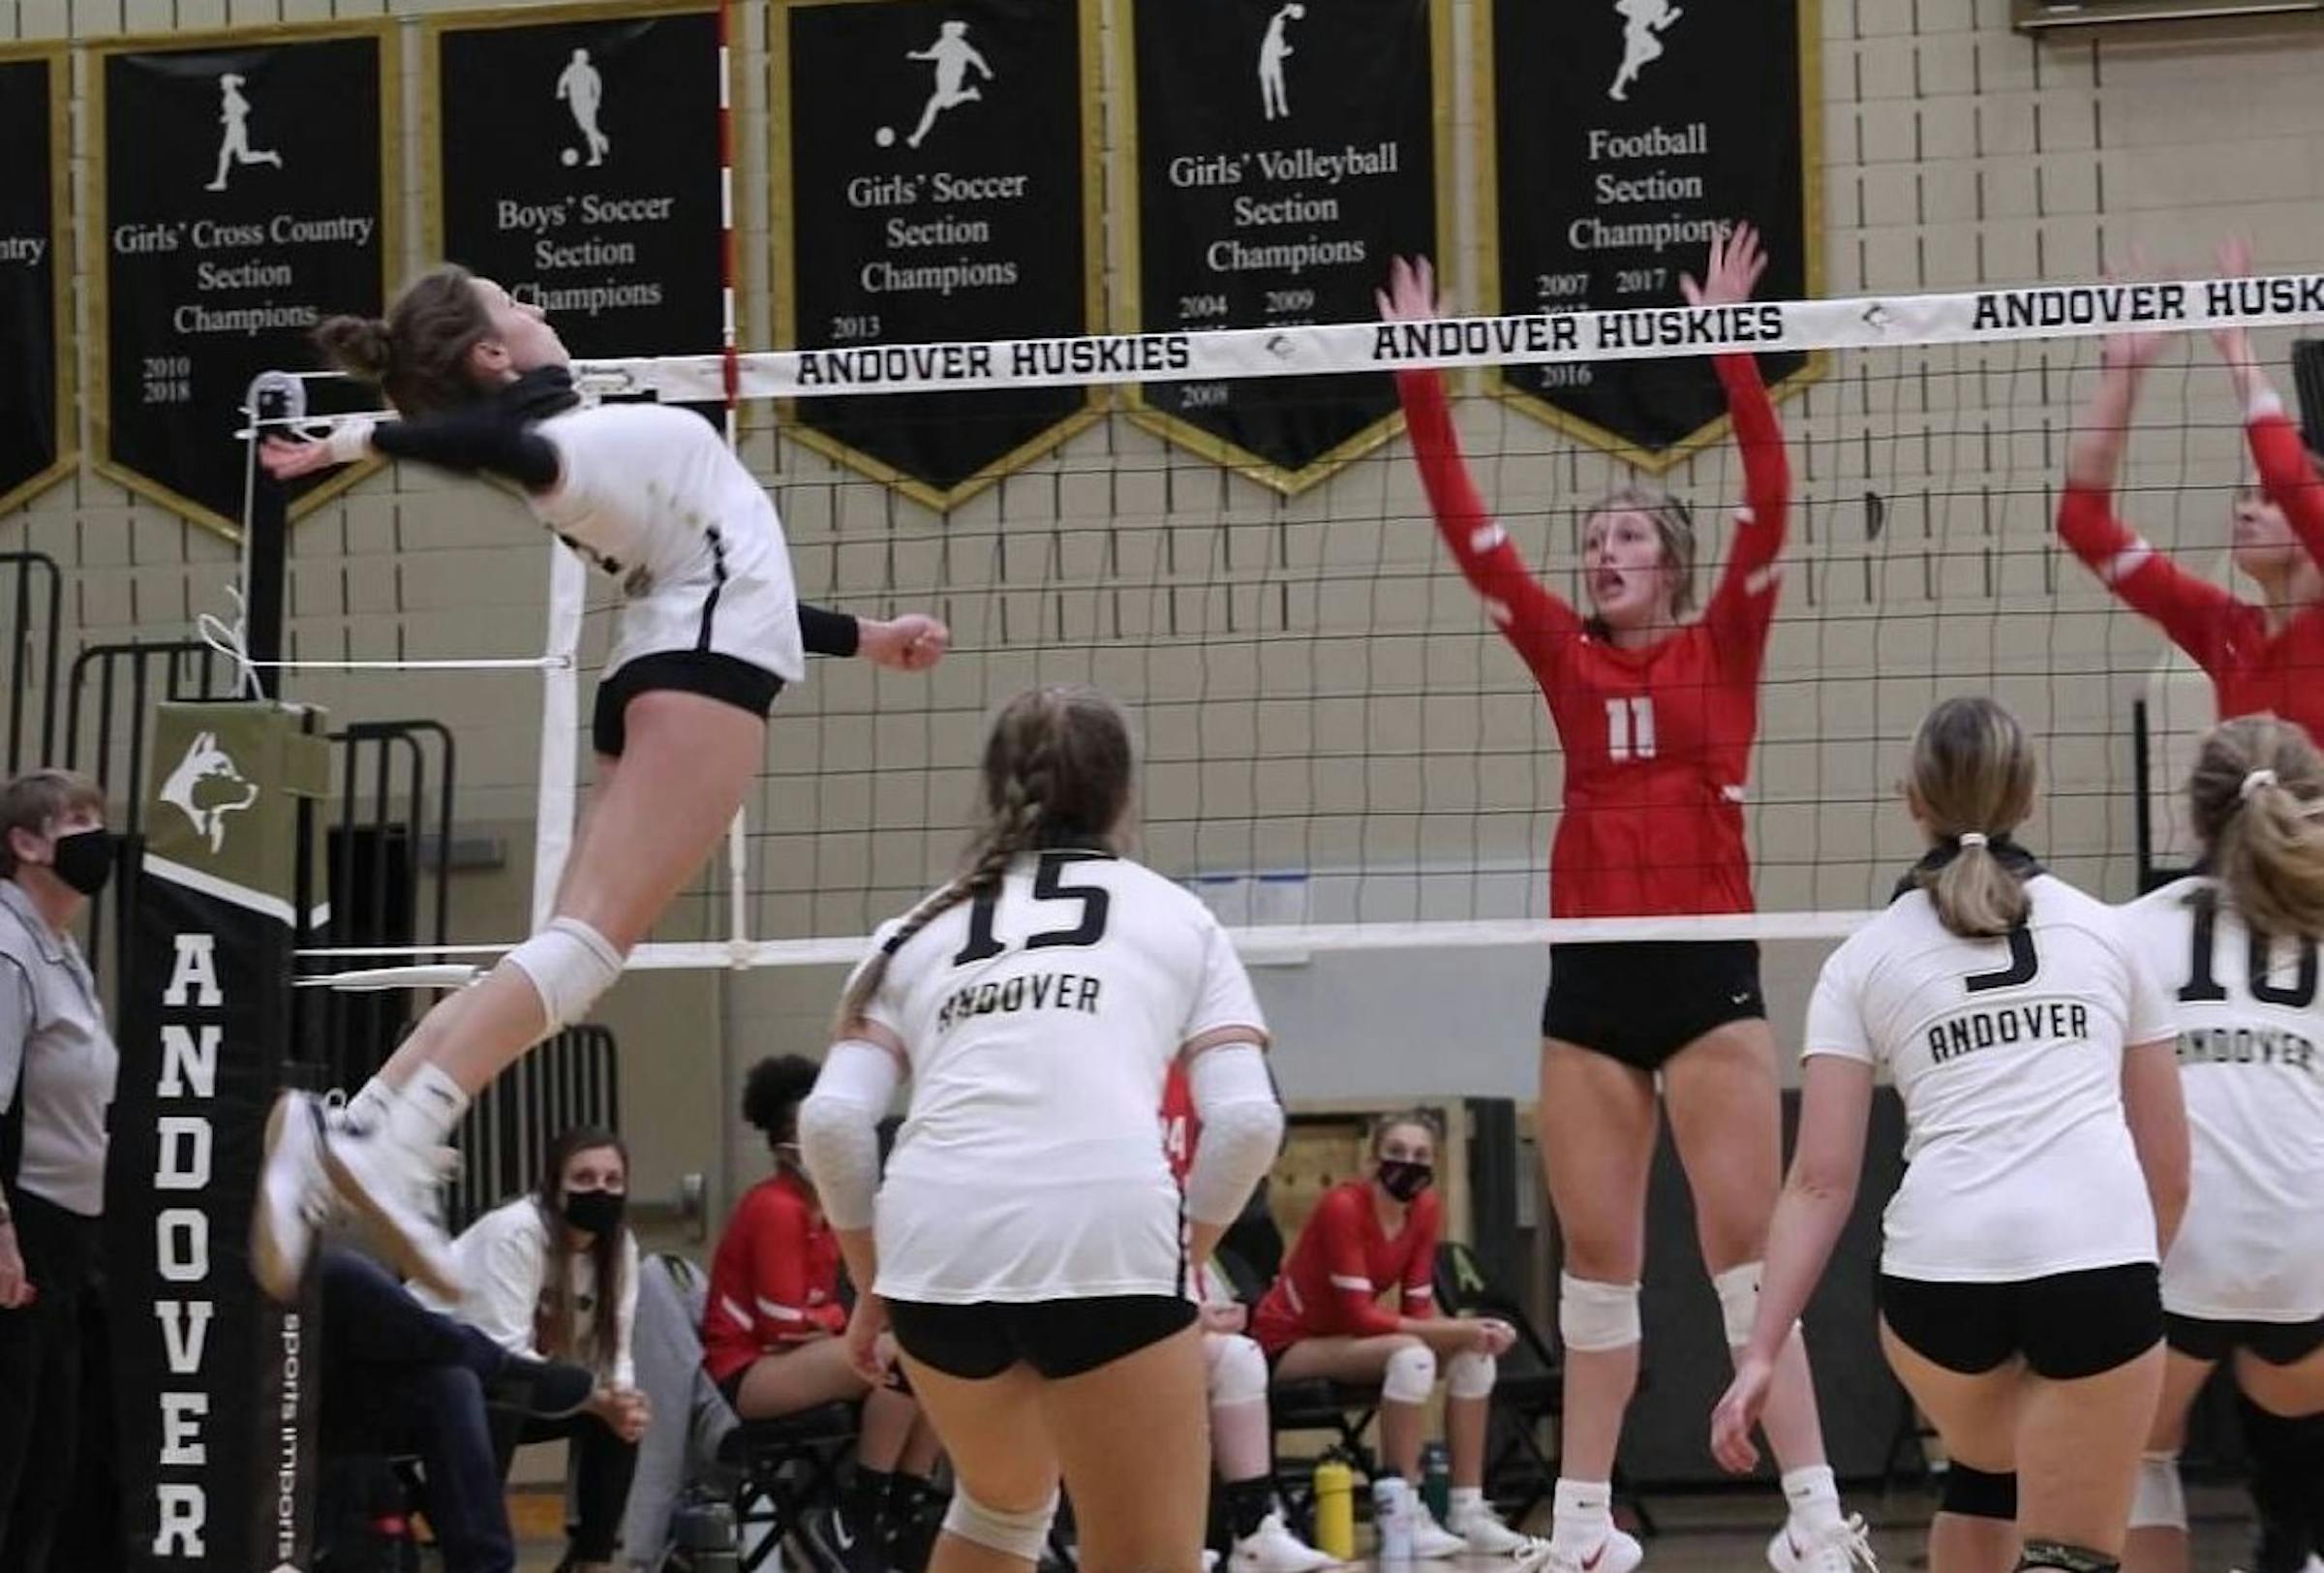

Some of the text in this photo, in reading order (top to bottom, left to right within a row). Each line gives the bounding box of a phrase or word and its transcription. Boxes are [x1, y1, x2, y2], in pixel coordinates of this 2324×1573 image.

[1588, 123, 1708, 160] Football
[1169, 142, 1398, 187] Girls' Volleyball
[847, 172, 1028, 207] Girls' Soccer
[1595, 170, 1703, 204] Section
[498, 194, 675, 233] Boys' Soccer
[1234, 193, 1339, 226] Section
[114, 215, 374, 254] Girls' Cross Country
[886, 214, 990, 248] Section
[1568, 213, 1732, 253] Champions
[535, 236, 636, 269] Section
[1208, 235, 1365, 274] Champions
[197, 260, 291, 291] Section
[861, 257, 1018, 295] Champions
[1537, 268, 1667, 297] 2007 2017
[511, 278, 662, 316] Champions
[1179, 290, 1315, 320] 2004 2009
[1972, 277, 2324, 330] ANDOVER HUSK
[174, 300, 318, 336] Champions
[832, 315, 881, 339] 2013
[1373, 306, 1784, 359] ANDOVER HUSKIES
[142, 356, 192, 378] 2010
[797, 336, 1188, 385] ANDOVER HUSKIES
[1541, 364, 1593, 388] 2016
[1605, 696, 1656, 763] 11
[954, 853, 1112, 968] 15
[937, 972, 1101, 1033] ANDOVER
[1928, 1003, 2087, 1064] ANDOVER
[152, 933, 224, 1558] ANDOVER
[277, 1313, 300, 1560] sports imports
